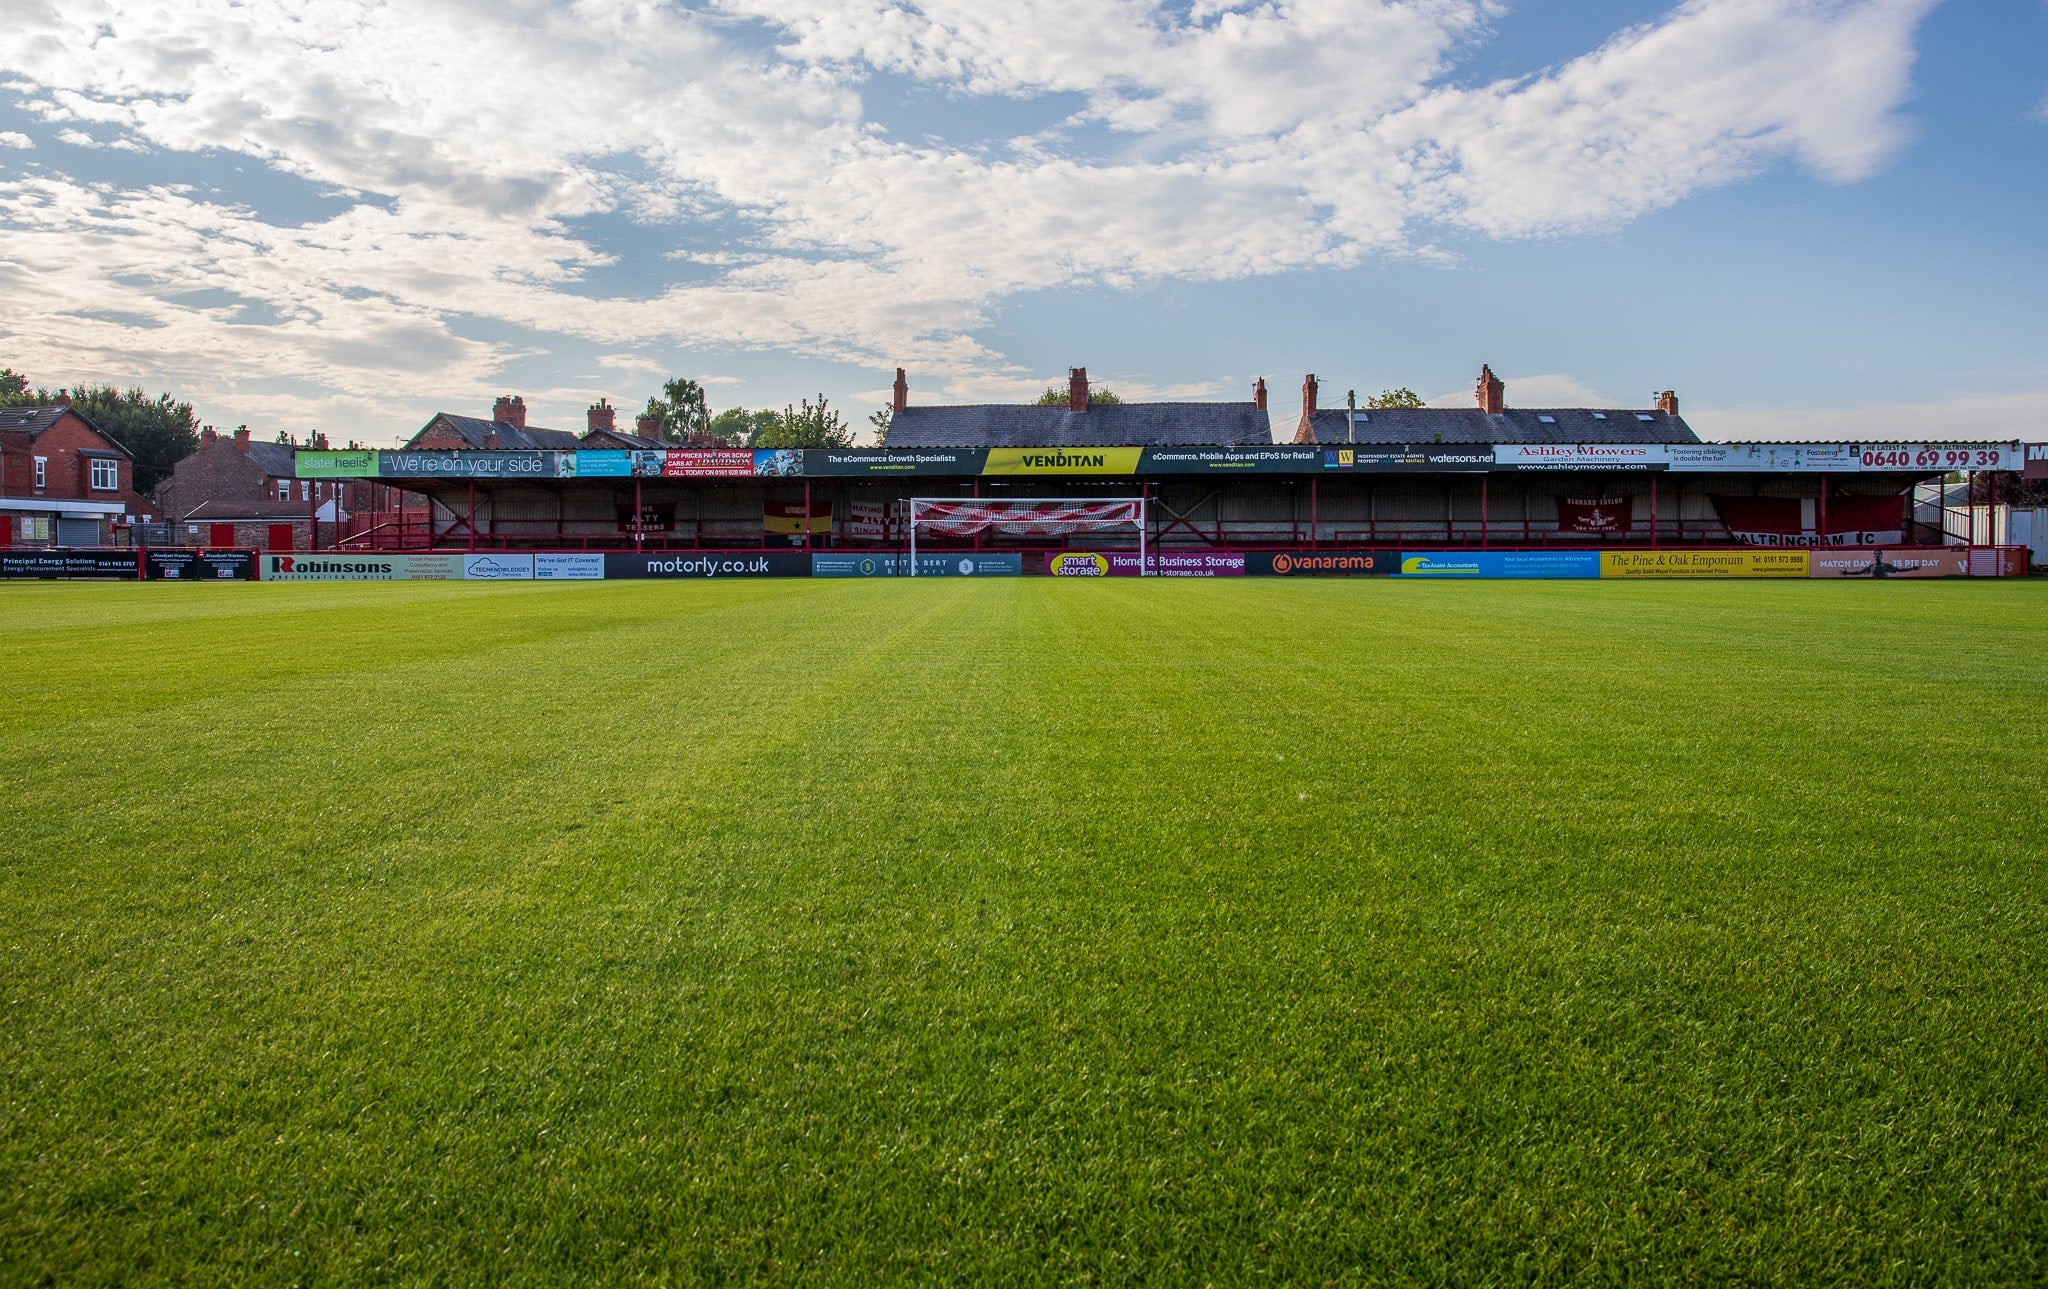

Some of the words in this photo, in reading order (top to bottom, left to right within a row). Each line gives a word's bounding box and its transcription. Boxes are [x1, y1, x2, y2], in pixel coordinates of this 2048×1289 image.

[1152, 453, 1198, 461] eCommerce,
[1199, 452, 1224, 460] Mobile
[1224, 452, 1244, 461] Apps
[1245, 452, 1259, 460] and
[1260, 452, 1280, 460] EPoS
[1280, 451, 1291, 459] for
[1292, 451, 1314, 459] Retail
[1325, 452, 1337, 461] W
[1339, 451, 1353, 461] W
[1518, 446, 1576, 457] Ashley
[1579, 446, 1646, 456] Mowers
[1702, 448, 1726, 457] siblings
[1807, 449, 1838, 457] Fostering
[304, 457, 369, 469] slaterheelis
[828, 455, 842, 463] The
[843, 454, 887, 463] eCommerce
[888, 454, 915, 463] Growth
[915, 454, 956, 464] Specialists
[1022, 455, 1104, 467] VENDITAN
[1429, 454, 1494, 463] watersons.net
[1862, 451, 1910, 467] 0640
[1915, 451, 1940, 467] 69
[1945, 451, 1969, 466] 99
[1975, 451, 1999, 466] 39
[390, 455, 438, 471] We're
[442, 459, 463, 472] on
[468, 458, 504, 475] your
[508, 456, 542, 472] side
[1517, 463, 1647, 471] www.ashleymowers.com
[1599, 497, 1623, 506] TAYLOR
[853, 504, 882, 514] HATING
[863, 516, 892, 525] ALTY
[625, 523, 665, 531] TESERS
[1738, 532, 1844, 547] ALTRNCHAM
[4, 558, 37, 566] Principal
[39, 558, 64, 566] Energy
[1063, 555, 1096, 565] smart
[1113, 556, 1142, 566] Home
[1147, 556, 1155, 566] &
[1158, 556, 1202, 566] Business
[1205, 556, 1245, 569] Storage
[1293, 556, 1374, 569] vanarama
[1611, 554, 1630, 566] The
[1632, 554, 1653, 566] Pine
[1656, 555, 1665, 566] &
[1669, 554, 1688, 565] Oak
[1692, 553, 1743, 568] Emporium
[1778, 555, 1789, 563] 973
[272, 556, 392, 573] Robinsons
[647, 556, 769, 577] motorly.co.uk
[1058, 566, 1101, 576] storage
[1144, 569, 1214, 577] smat-storage.co.uk
